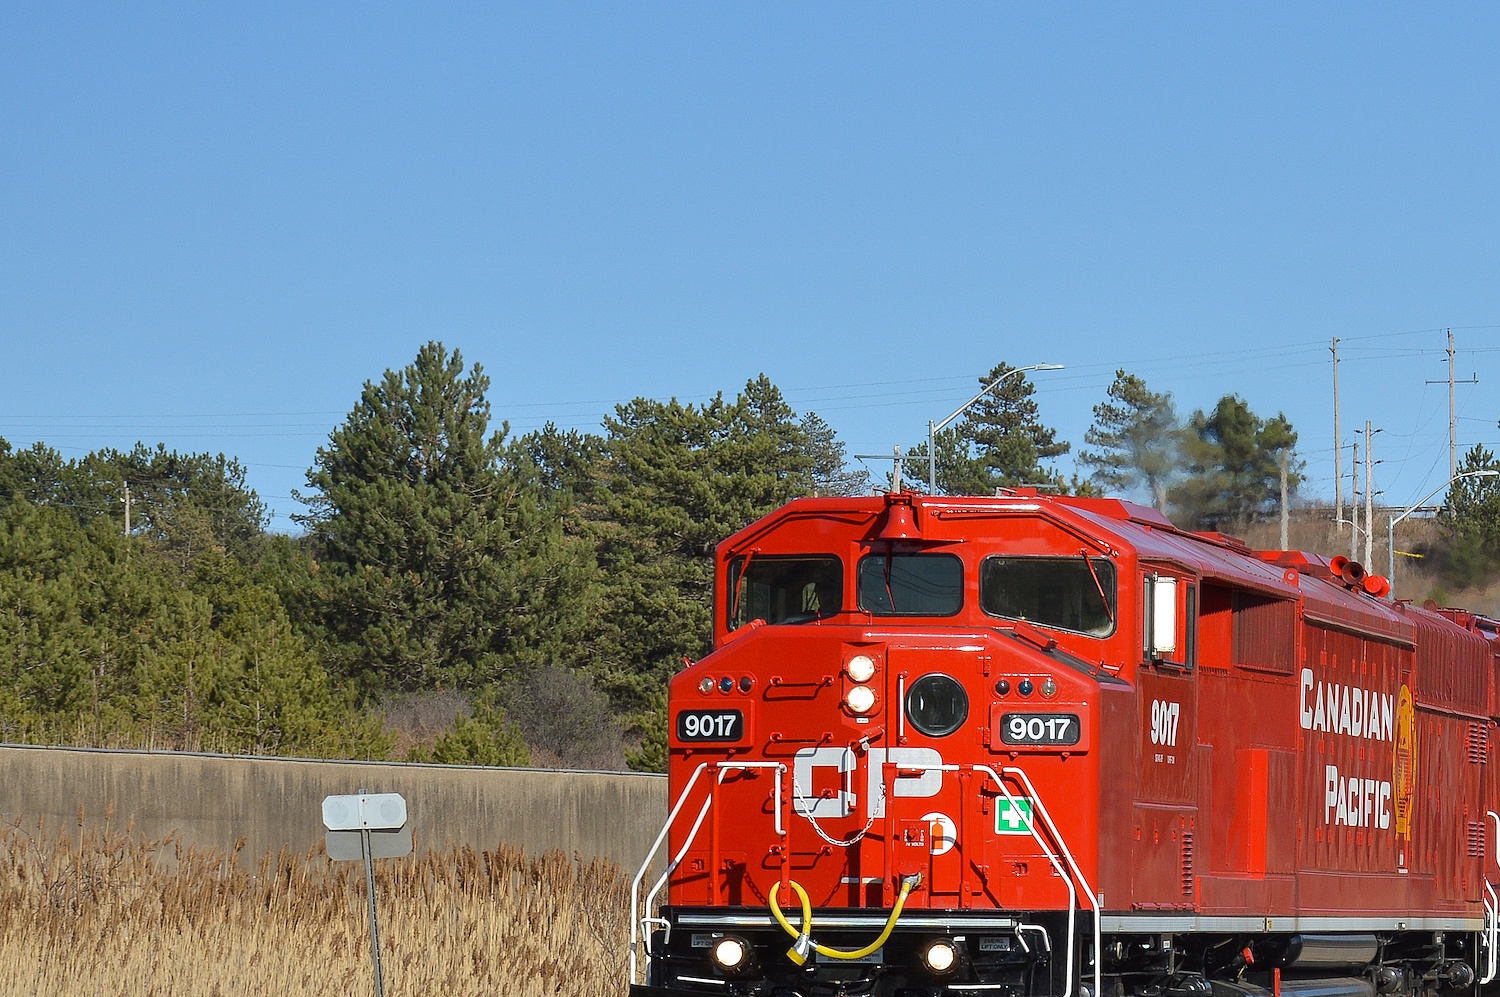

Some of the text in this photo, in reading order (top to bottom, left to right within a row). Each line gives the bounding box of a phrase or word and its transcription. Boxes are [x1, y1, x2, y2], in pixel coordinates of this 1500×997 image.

[685, 714, 737, 737] 9017
[1009, 717, 1071, 740] 9017
[1150, 699, 1180, 747] 9017
[1299, 667, 1394, 742] CANADIAN
[793, 747, 942, 818] CP
[1325, 764, 1391, 830] PACIFIC
